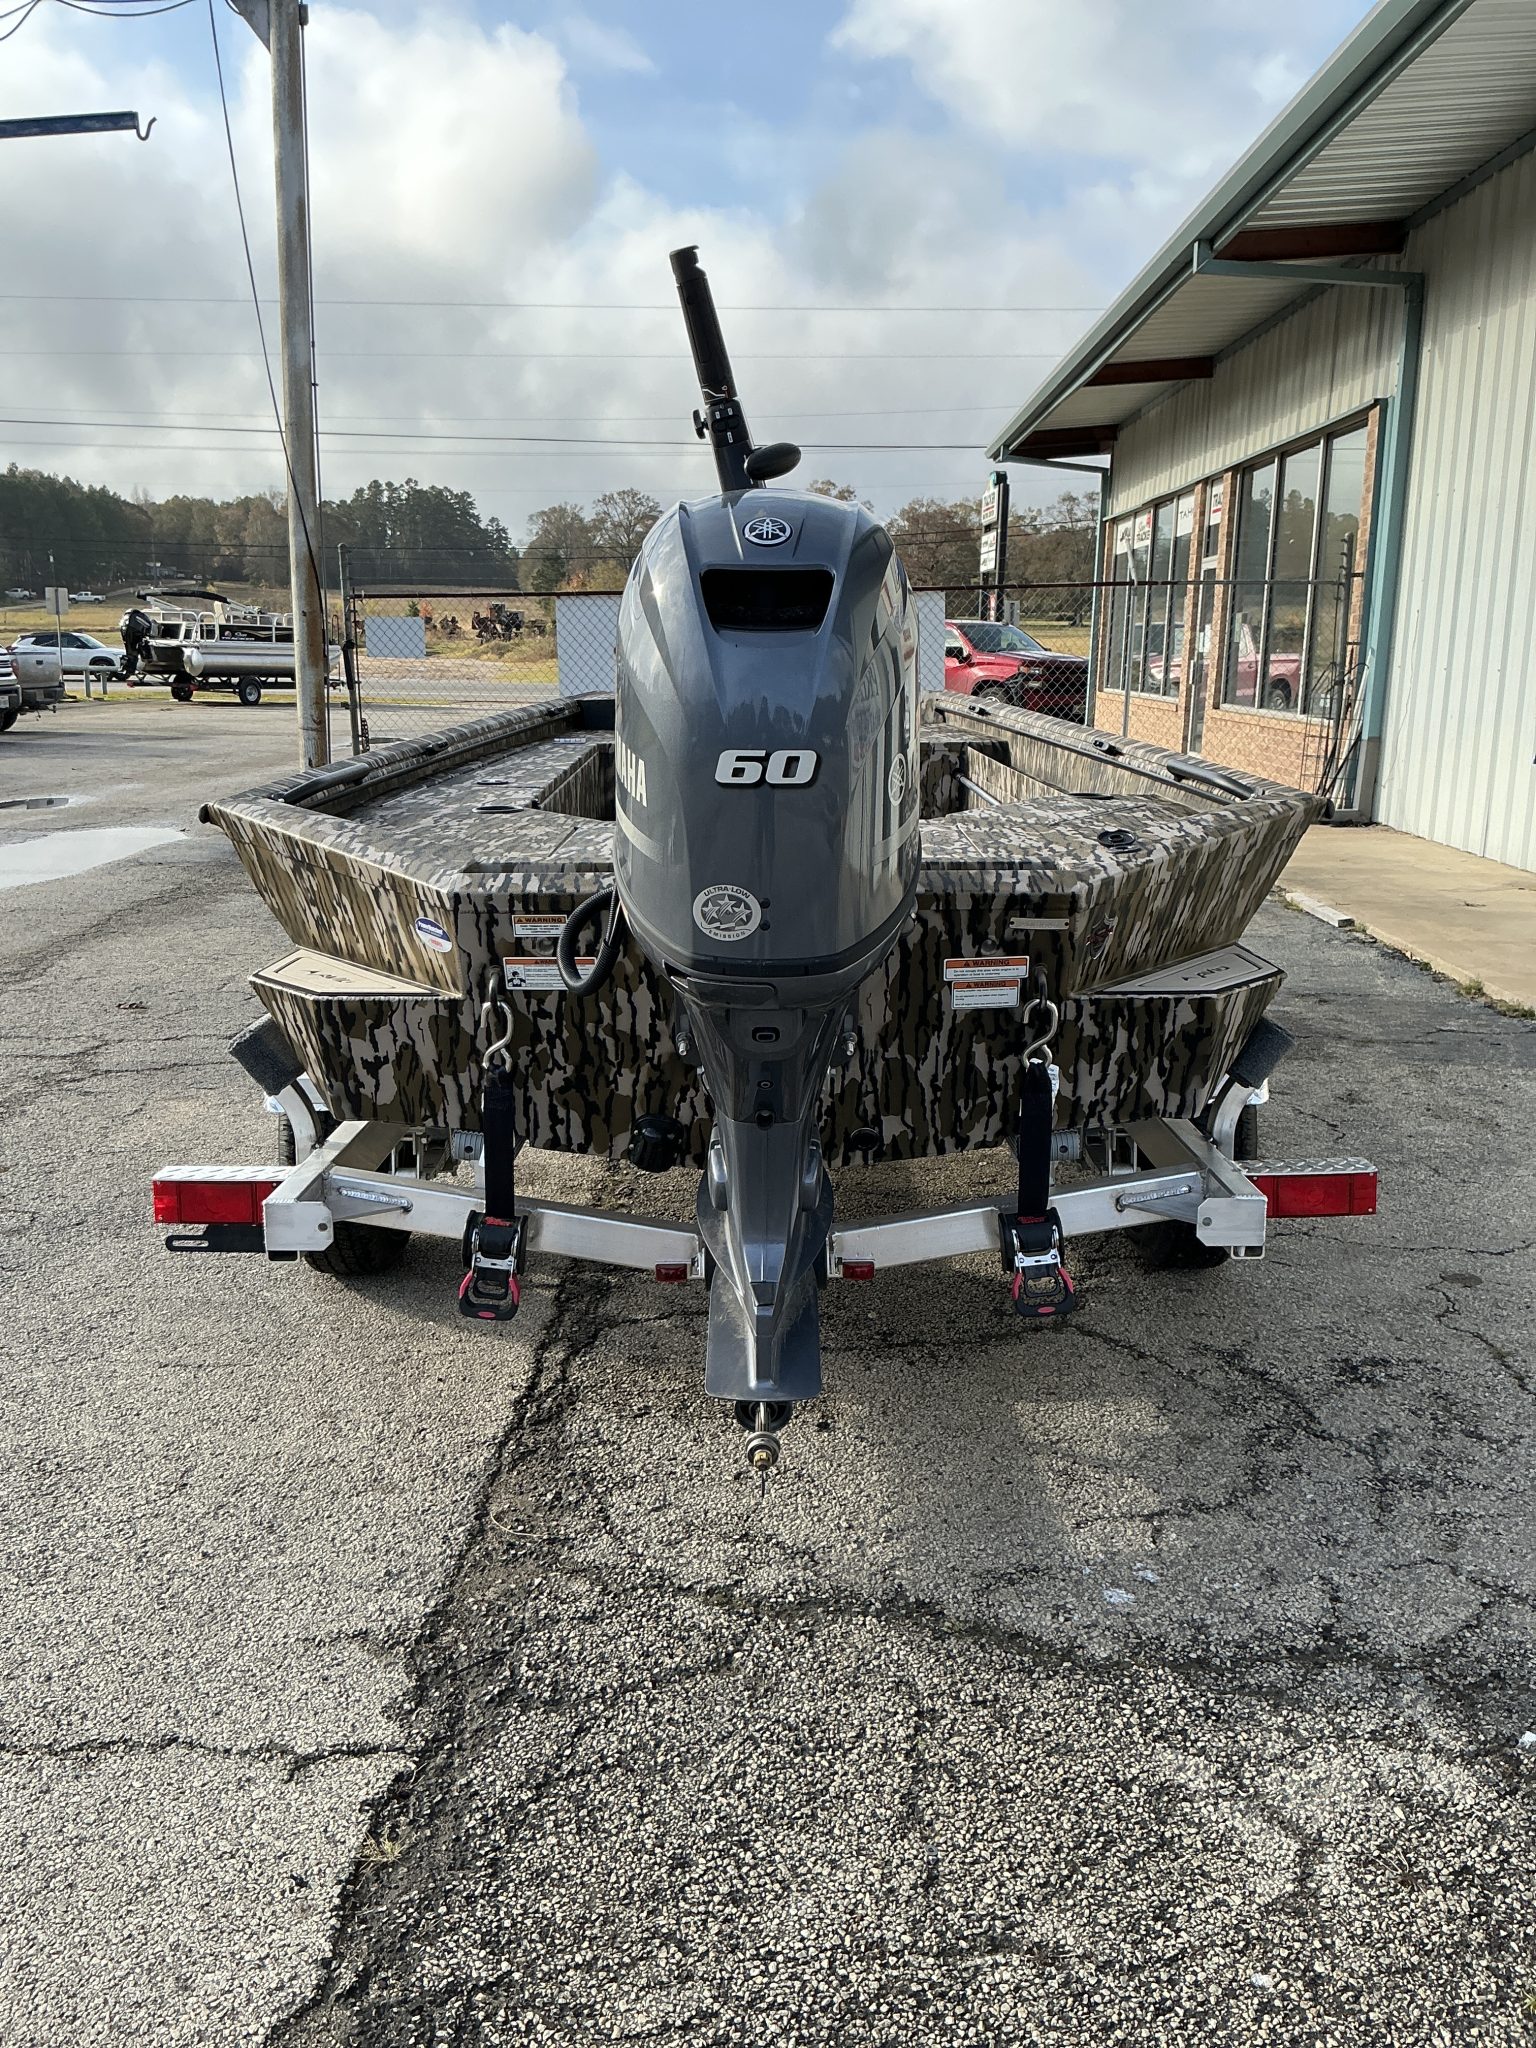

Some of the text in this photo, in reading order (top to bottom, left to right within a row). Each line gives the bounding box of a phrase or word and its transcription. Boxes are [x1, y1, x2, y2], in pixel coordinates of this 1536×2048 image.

[714, 749, 818, 785] 60
[708, 929, 746, 939] EMISSION
[972, 959, 1010, 967] WARNING
[974, 980, 1007, 988] WARNING
